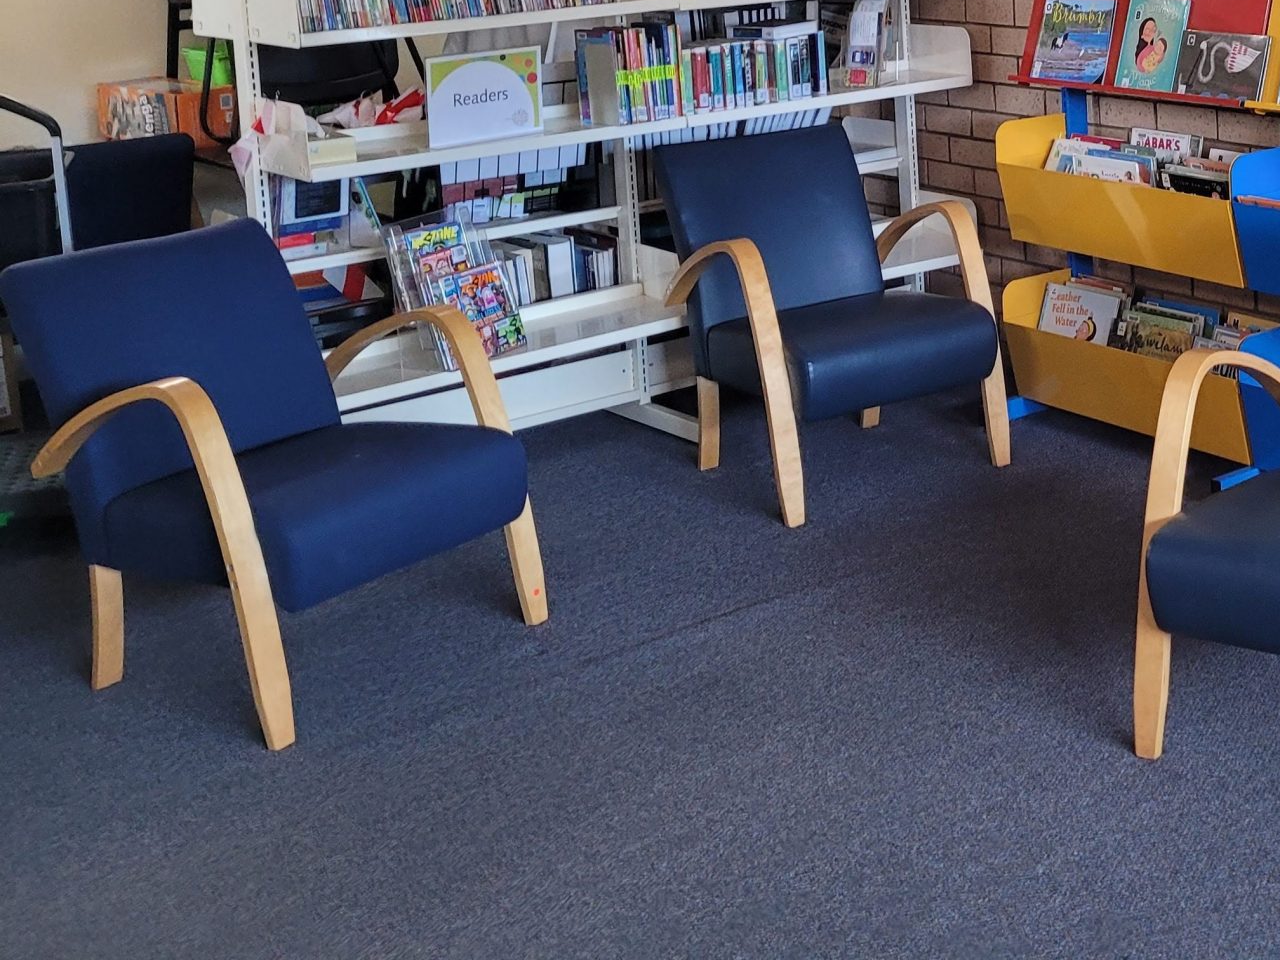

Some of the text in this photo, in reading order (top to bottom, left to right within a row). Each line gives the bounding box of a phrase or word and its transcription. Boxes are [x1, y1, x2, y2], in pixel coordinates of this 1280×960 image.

[1053, 2, 1106, 28] Brumby
[1188, 35, 1194, 45] C
[453, 89, 509, 107] Readers
[1142, 136, 1181, 151] ABAR'S
[1051, 291, 1082, 304] eather
[1052, 303, 1088, 316] Fell in the
[1055, 316, 1077, 328] Water
